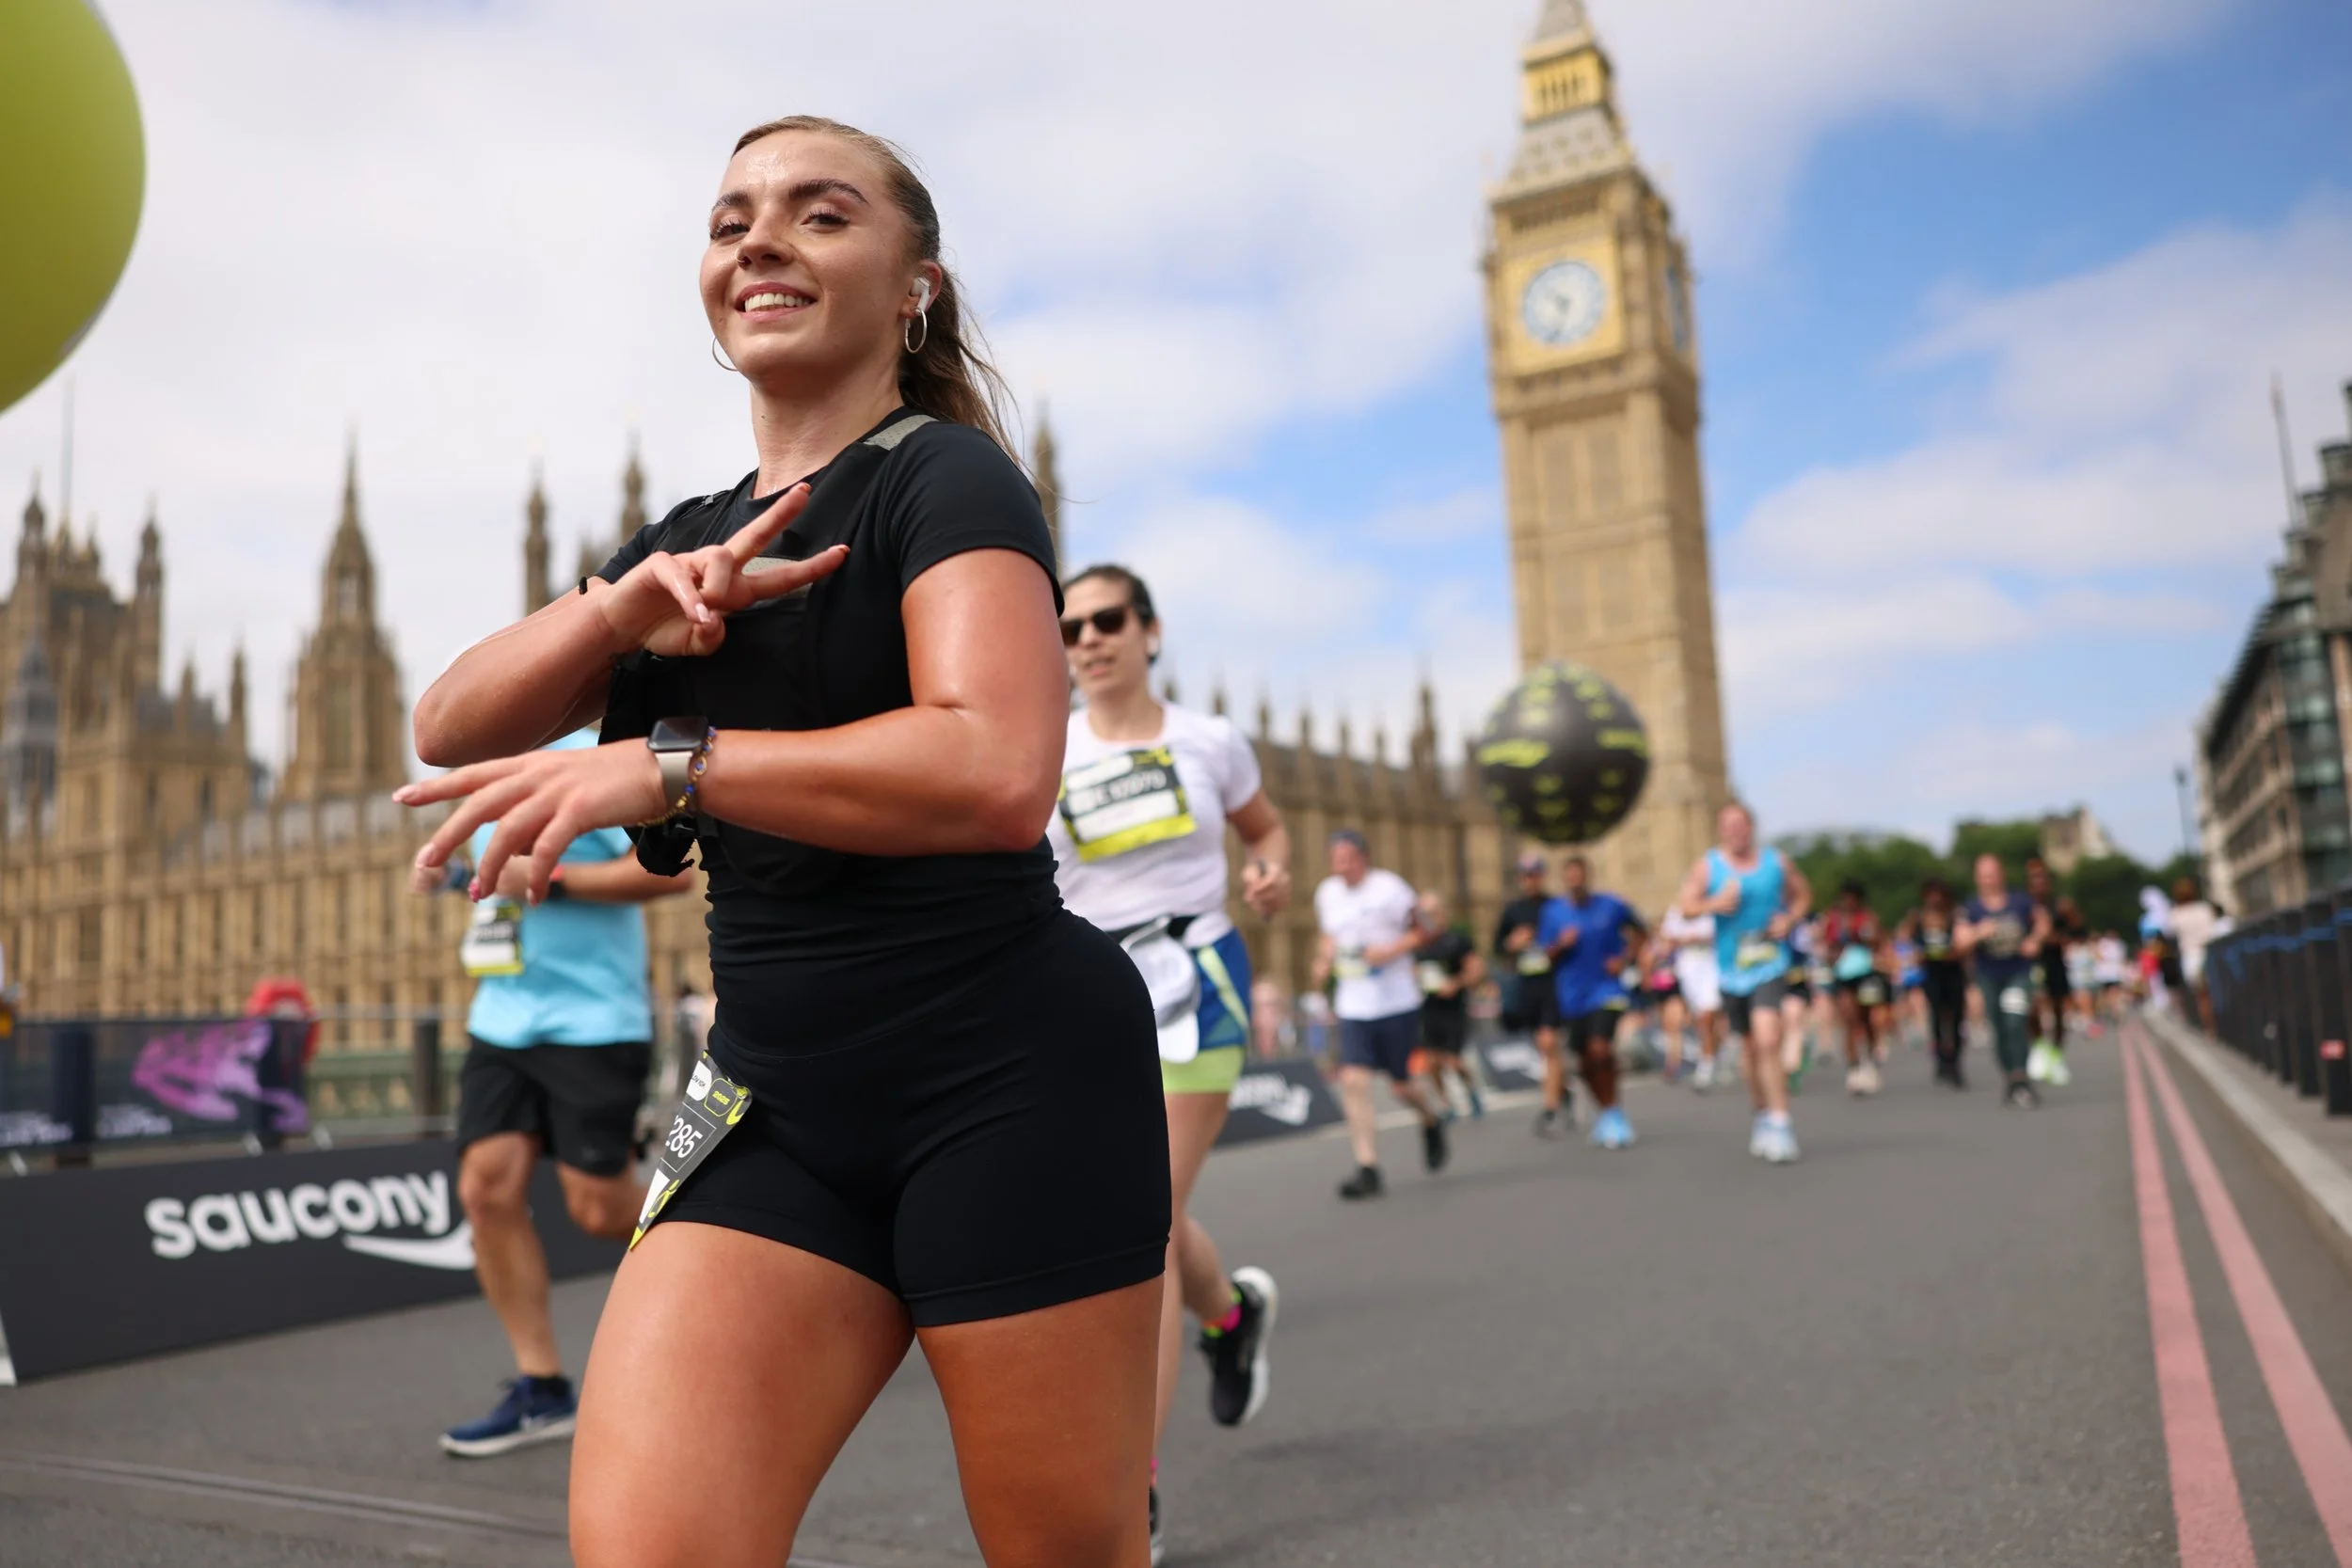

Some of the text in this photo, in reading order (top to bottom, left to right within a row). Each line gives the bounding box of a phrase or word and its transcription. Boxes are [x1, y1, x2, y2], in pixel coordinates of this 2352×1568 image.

[712, 1090, 730, 1105] 2025
[665, 1115, 704, 1158] 285
[145, 1171, 451, 1259] saucony
